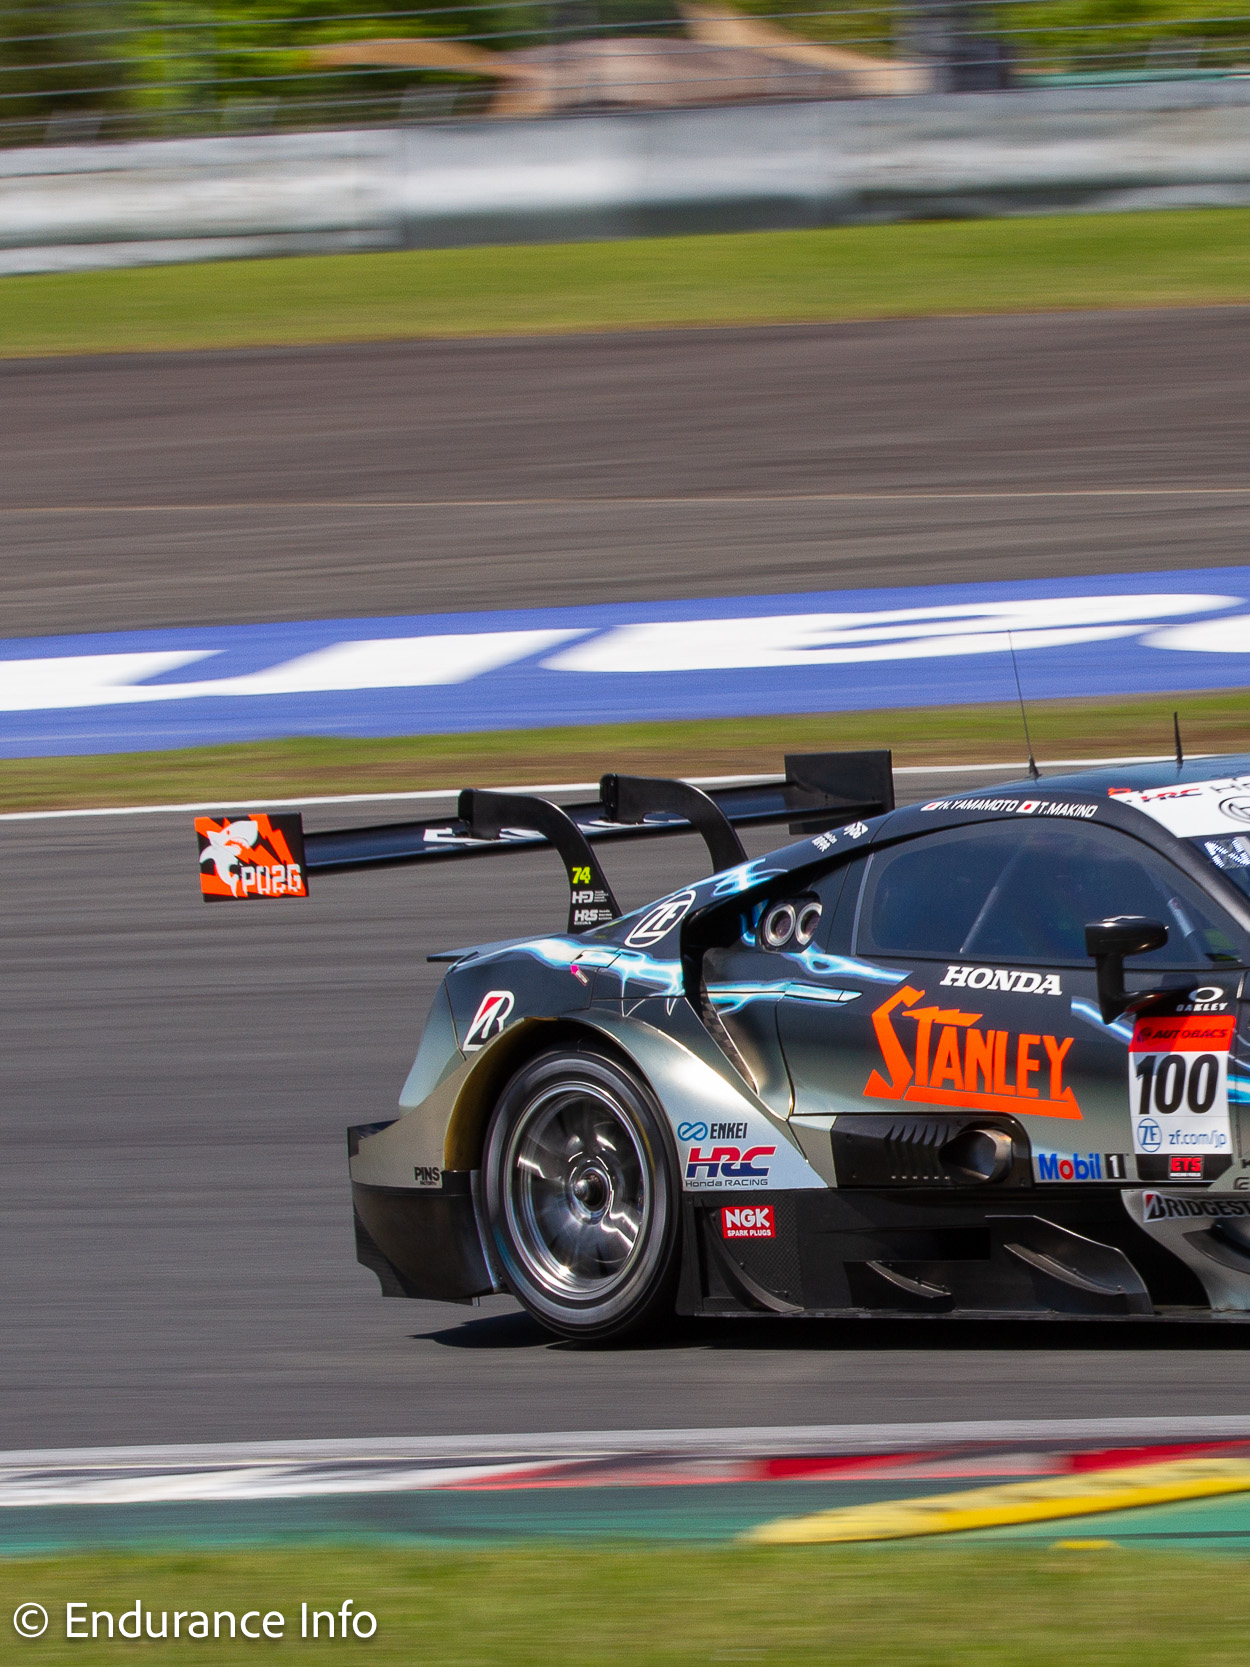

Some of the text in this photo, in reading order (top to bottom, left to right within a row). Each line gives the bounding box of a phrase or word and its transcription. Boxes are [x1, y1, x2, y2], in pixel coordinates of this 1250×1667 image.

[938, 799, 1019, 812] N.YAMAMOTO
[1037, 801, 1099, 818] T.MAKINO
[572, 866, 591, 884] 74
[939, 965, 1063, 995] HONDA
[1176, 1002, 1228, 1012] OAKLEY
[1152, 1029, 1228, 1039] AUTOBACS
[863, 985, 1083, 1119] STANLEY
[1136, 1054, 1219, 1115] 100
[709, 1122, 748, 1140] ENKEI
[1138, 1124, 1227, 1148] ZF zf.com/jp
[685, 1145, 778, 1179] HRC
[1038, 1153, 1101, 1180] Mobil
[1171, 1157, 1202, 1172] ETS
[414, 1166, 440, 1181] PINS
[685, 1178, 768, 1188] Honda RACING
[725, 1207, 770, 1228] NGK
[727, 1229, 771, 1237] SPARK PLUGS
